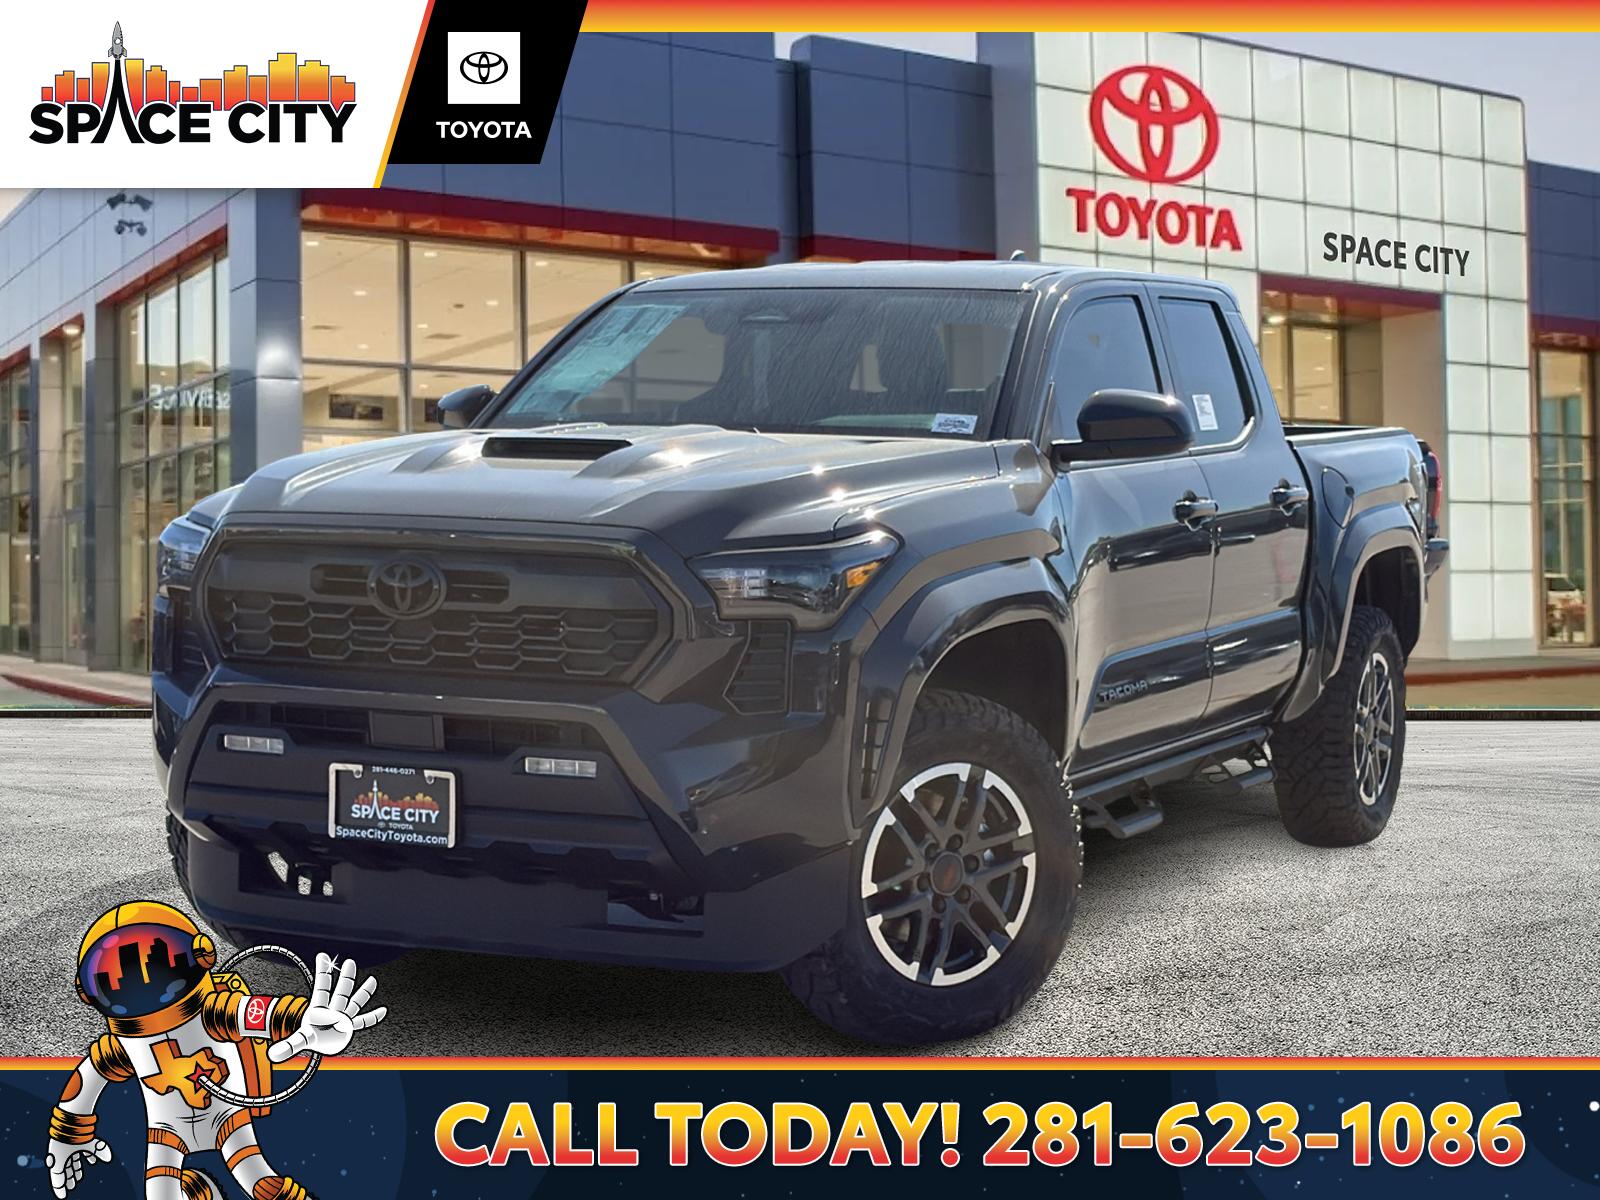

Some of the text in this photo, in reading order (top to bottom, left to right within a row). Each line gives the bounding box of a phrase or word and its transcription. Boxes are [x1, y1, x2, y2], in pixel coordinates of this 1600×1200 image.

[1066, 187, 1242, 251] TOYOTA
[1323, 231, 1470, 277] SPACE CITY
[1100, 680, 1148, 702] TACOMA
[372, 766, 416, 775] 281-446-0271
[351, 803, 440, 823] SPACE CITY
[336, 826, 448, 845] SpaceCityToyota.com
[388, 822, 414, 831] TOYOTA
